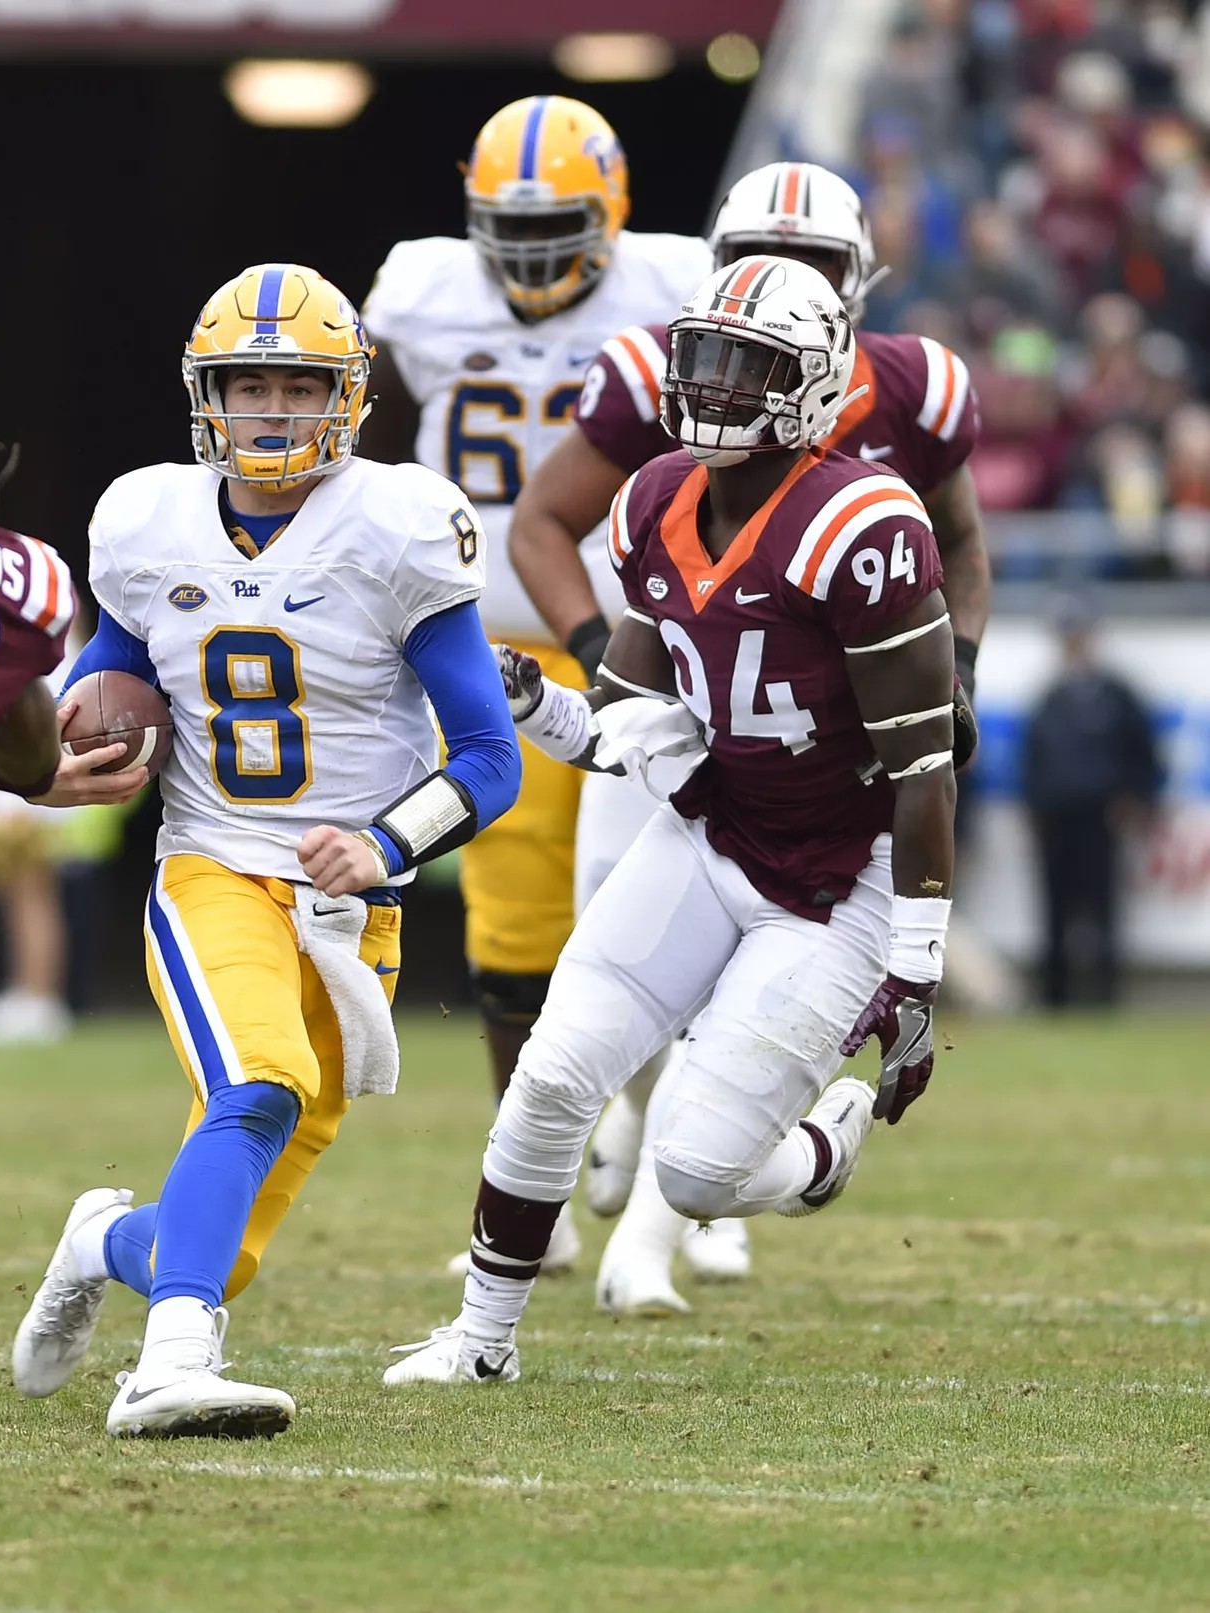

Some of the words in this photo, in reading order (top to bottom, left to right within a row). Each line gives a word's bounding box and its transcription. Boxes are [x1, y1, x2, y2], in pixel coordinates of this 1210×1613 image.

[762, 320, 792, 331] HOKIES
[250, 335, 281, 344] ACC
[448, 507, 477, 568] 8
[851, 530, 916, 605] 94
[172, 589, 203, 601] ACC
[230, 579, 261, 597] Pitt
[696, 579, 715, 597] VT
[659, 619, 817, 756] 94
[199, 624, 314, 805] 8
